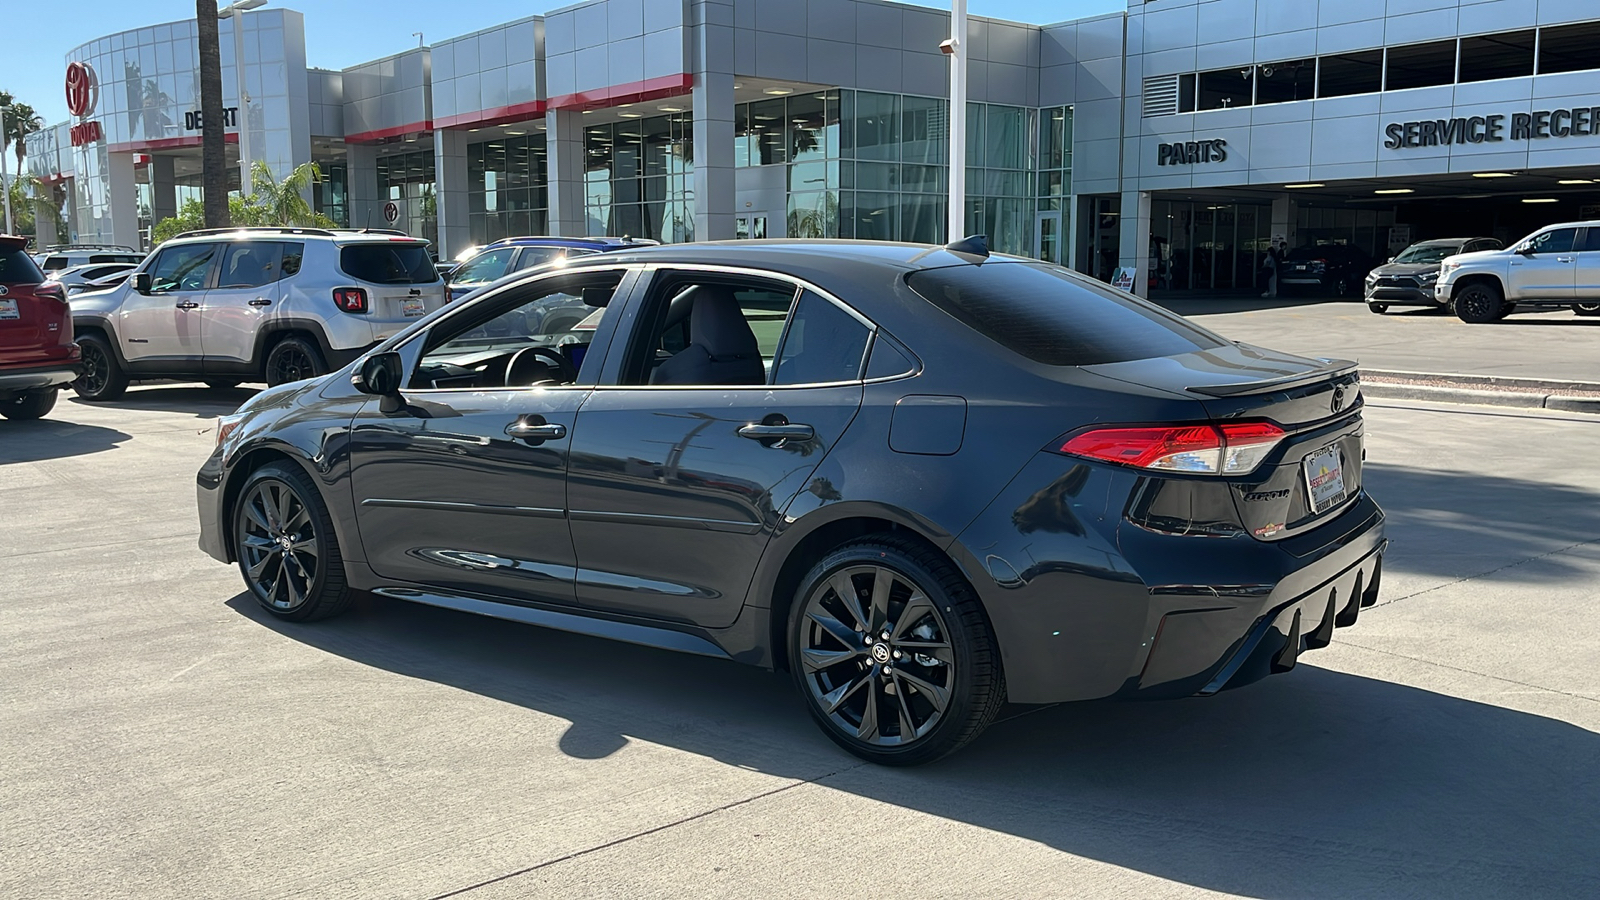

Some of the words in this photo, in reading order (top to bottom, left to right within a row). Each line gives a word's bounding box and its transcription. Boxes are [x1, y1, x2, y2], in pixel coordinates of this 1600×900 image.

[185, 107, 238, 131] DERT
[1384, 115, 1504, 149] SERVICE
[69, 121, 101, 147] TOYOTA
[1158, 138, 1227, 166] PARTS
